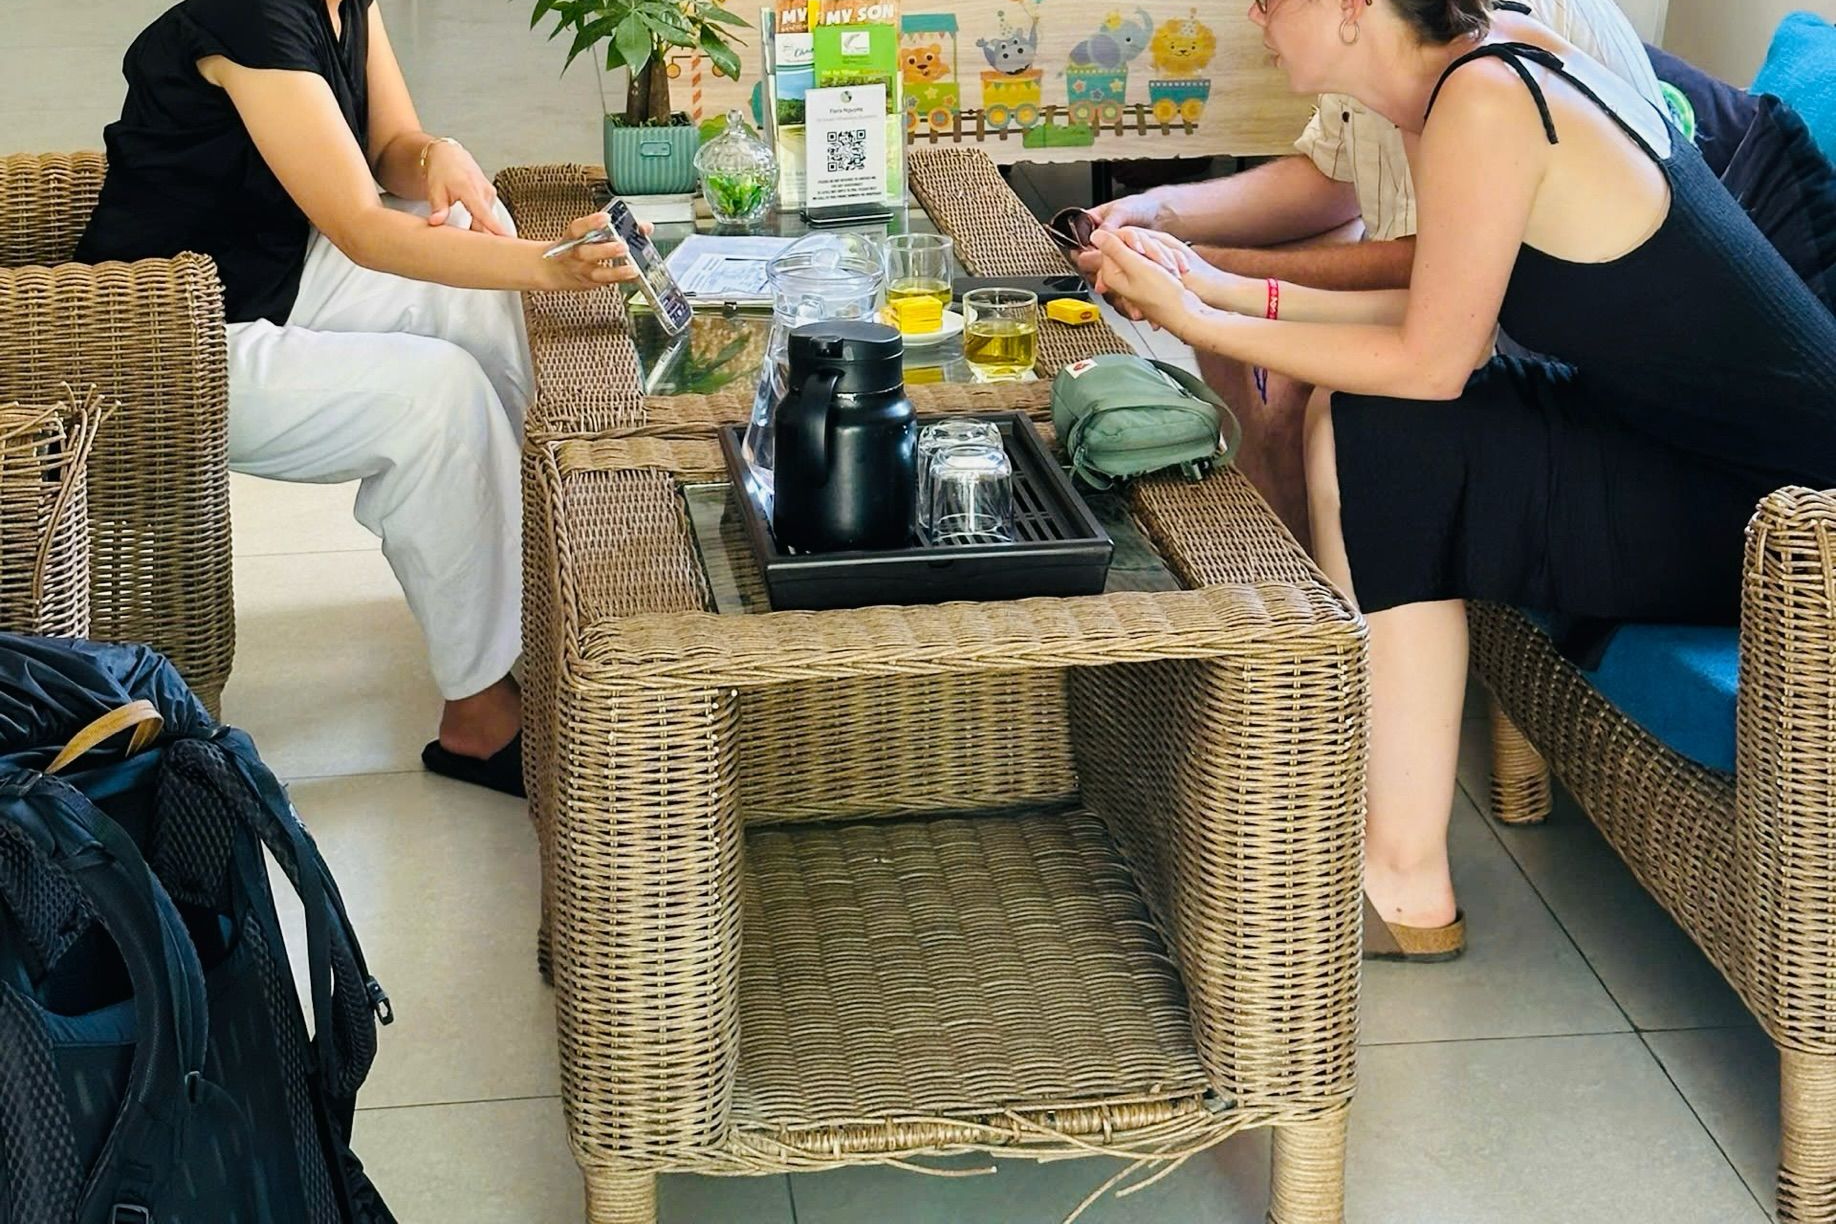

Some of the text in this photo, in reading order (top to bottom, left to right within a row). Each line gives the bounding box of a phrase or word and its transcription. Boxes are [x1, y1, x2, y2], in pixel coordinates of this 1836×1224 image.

[781, 7, 808, 25] MY
[825, 3, 894, 26] MY SON
